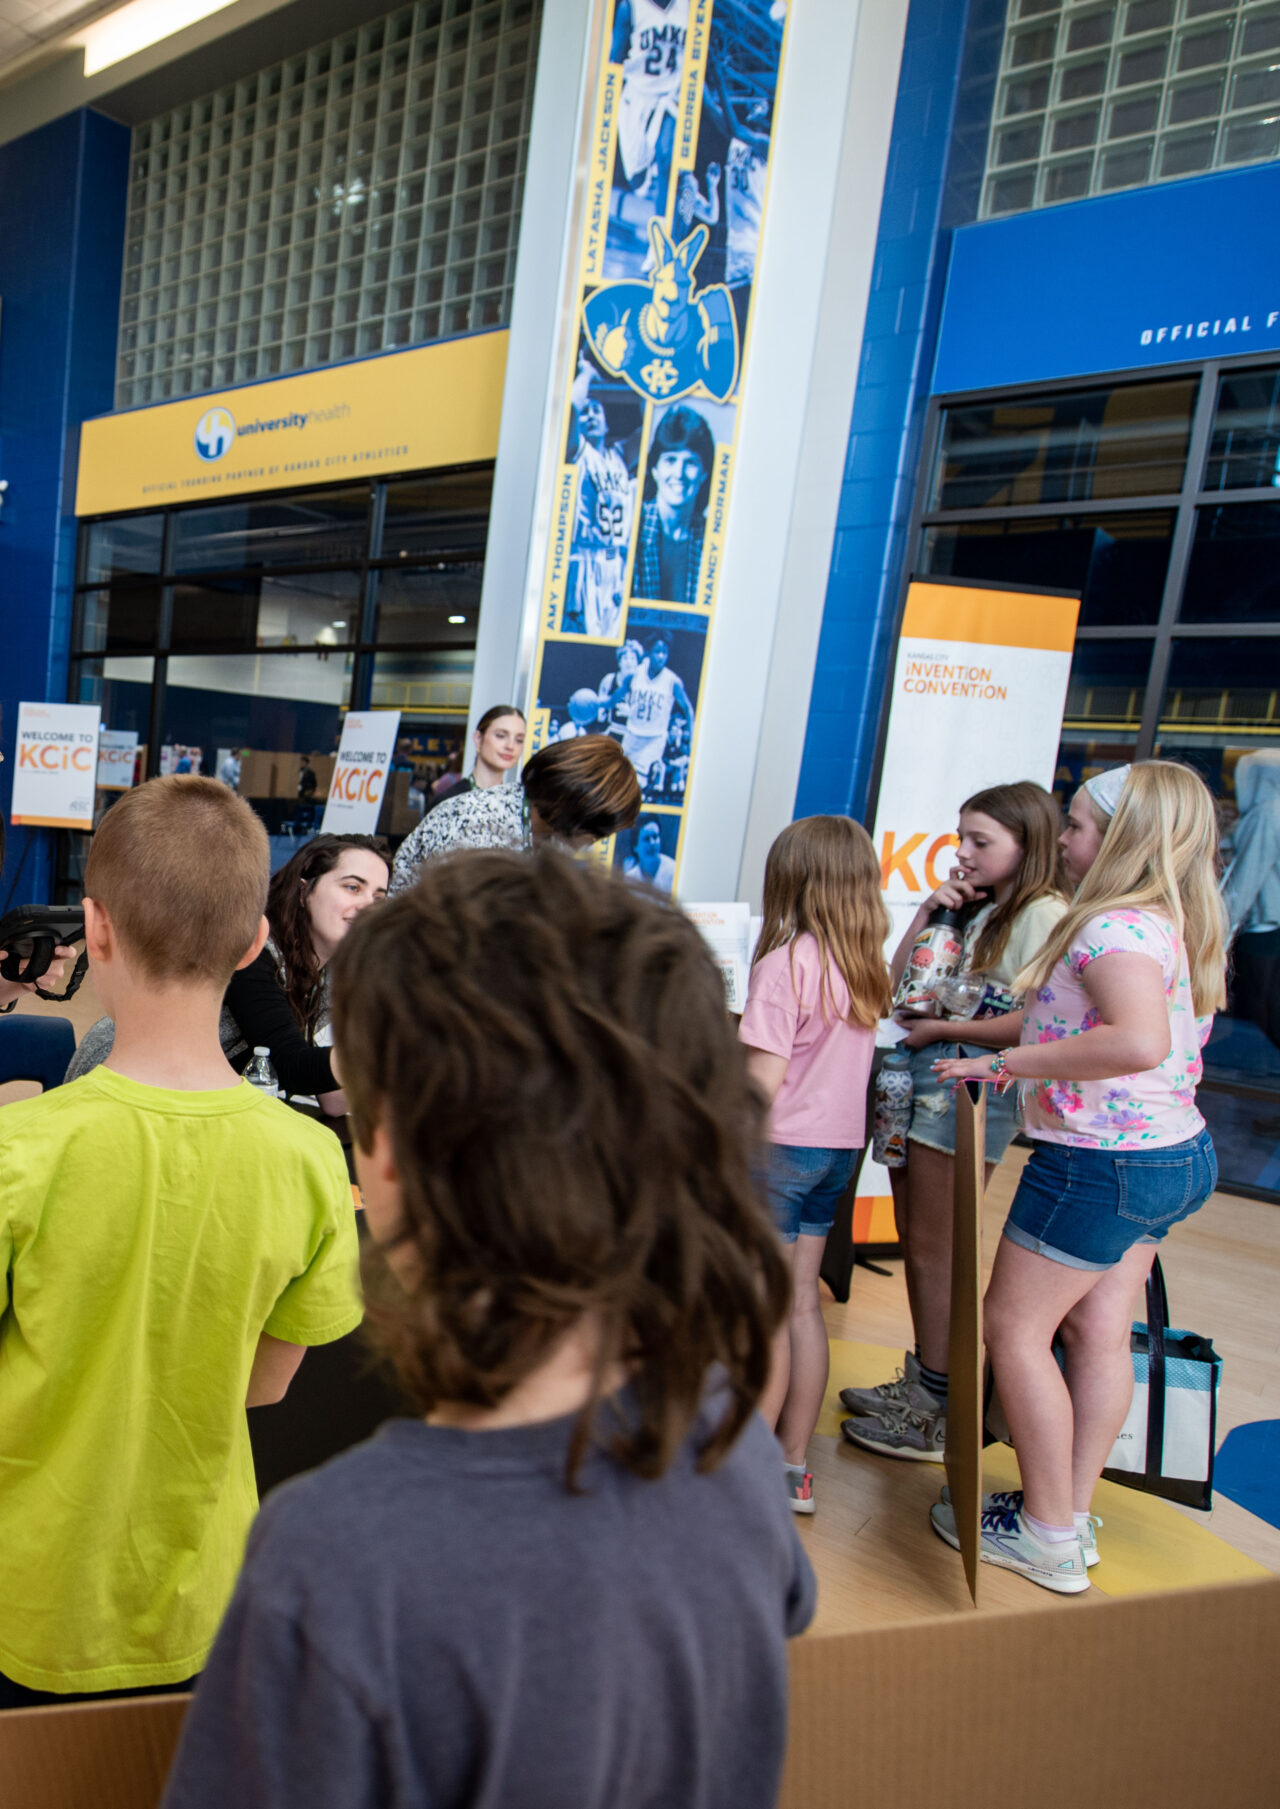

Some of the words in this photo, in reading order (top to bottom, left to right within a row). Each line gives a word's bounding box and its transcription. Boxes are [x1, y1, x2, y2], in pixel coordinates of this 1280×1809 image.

[645, 46, 677, 76] 24
[586, 179, 605, 275] LATASHA
[601, 73, 616, 172] JACKSON
[1140, 315, 1252, 346] OFFICIAL
[225, 468, 265, 482] PARTNER
[283, 459, 321, 473] KANSAS
[324, 455, 348, 468] CITY
[352, 444, 409, 463] ATHLETICS
[552, 473, 573, 582] THOMPSON
[600, 503, 623, 538] 52
[703, 541, 718, 606] NANCY
[713, 453, 731, 534] NORMAN
[547, 592, 559, 630] AMY
[21, 730, 75, 743] WELCOME
[79, 733, 93, 743] TO
[339, 751, 373, 764] WELCOME
[375, 752, 387, 764] TO
